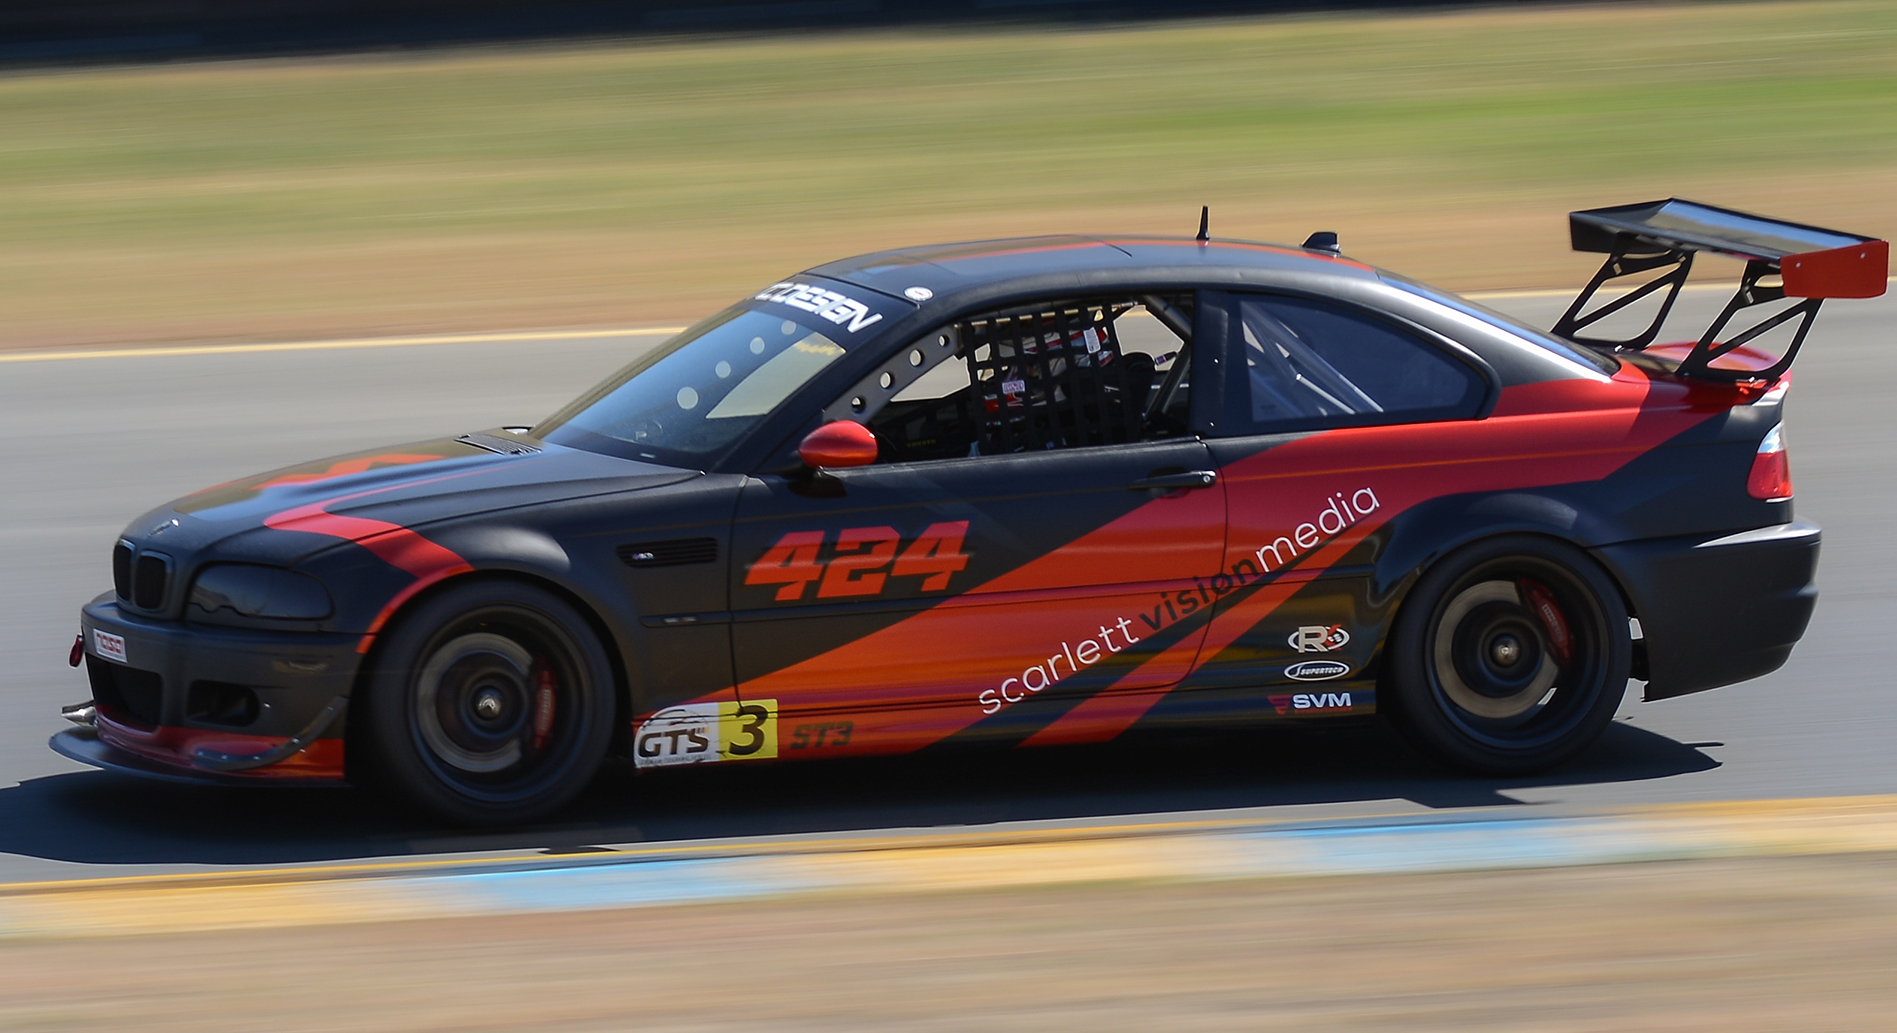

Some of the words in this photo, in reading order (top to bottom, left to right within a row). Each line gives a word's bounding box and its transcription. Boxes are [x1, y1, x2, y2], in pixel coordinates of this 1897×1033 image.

[744, 521, 970, 600] 424
[978, 616, 1140, 715] scarlett
[1138, 558, 1259, 632] vision
[1256, 487, 1380, 573] media
[1293, 693, 1352, 709] SVM
[637, 727, 709, 758] GTS
[729, 704, 768, 756] 3
[790, 720, 854, 751] ST3
